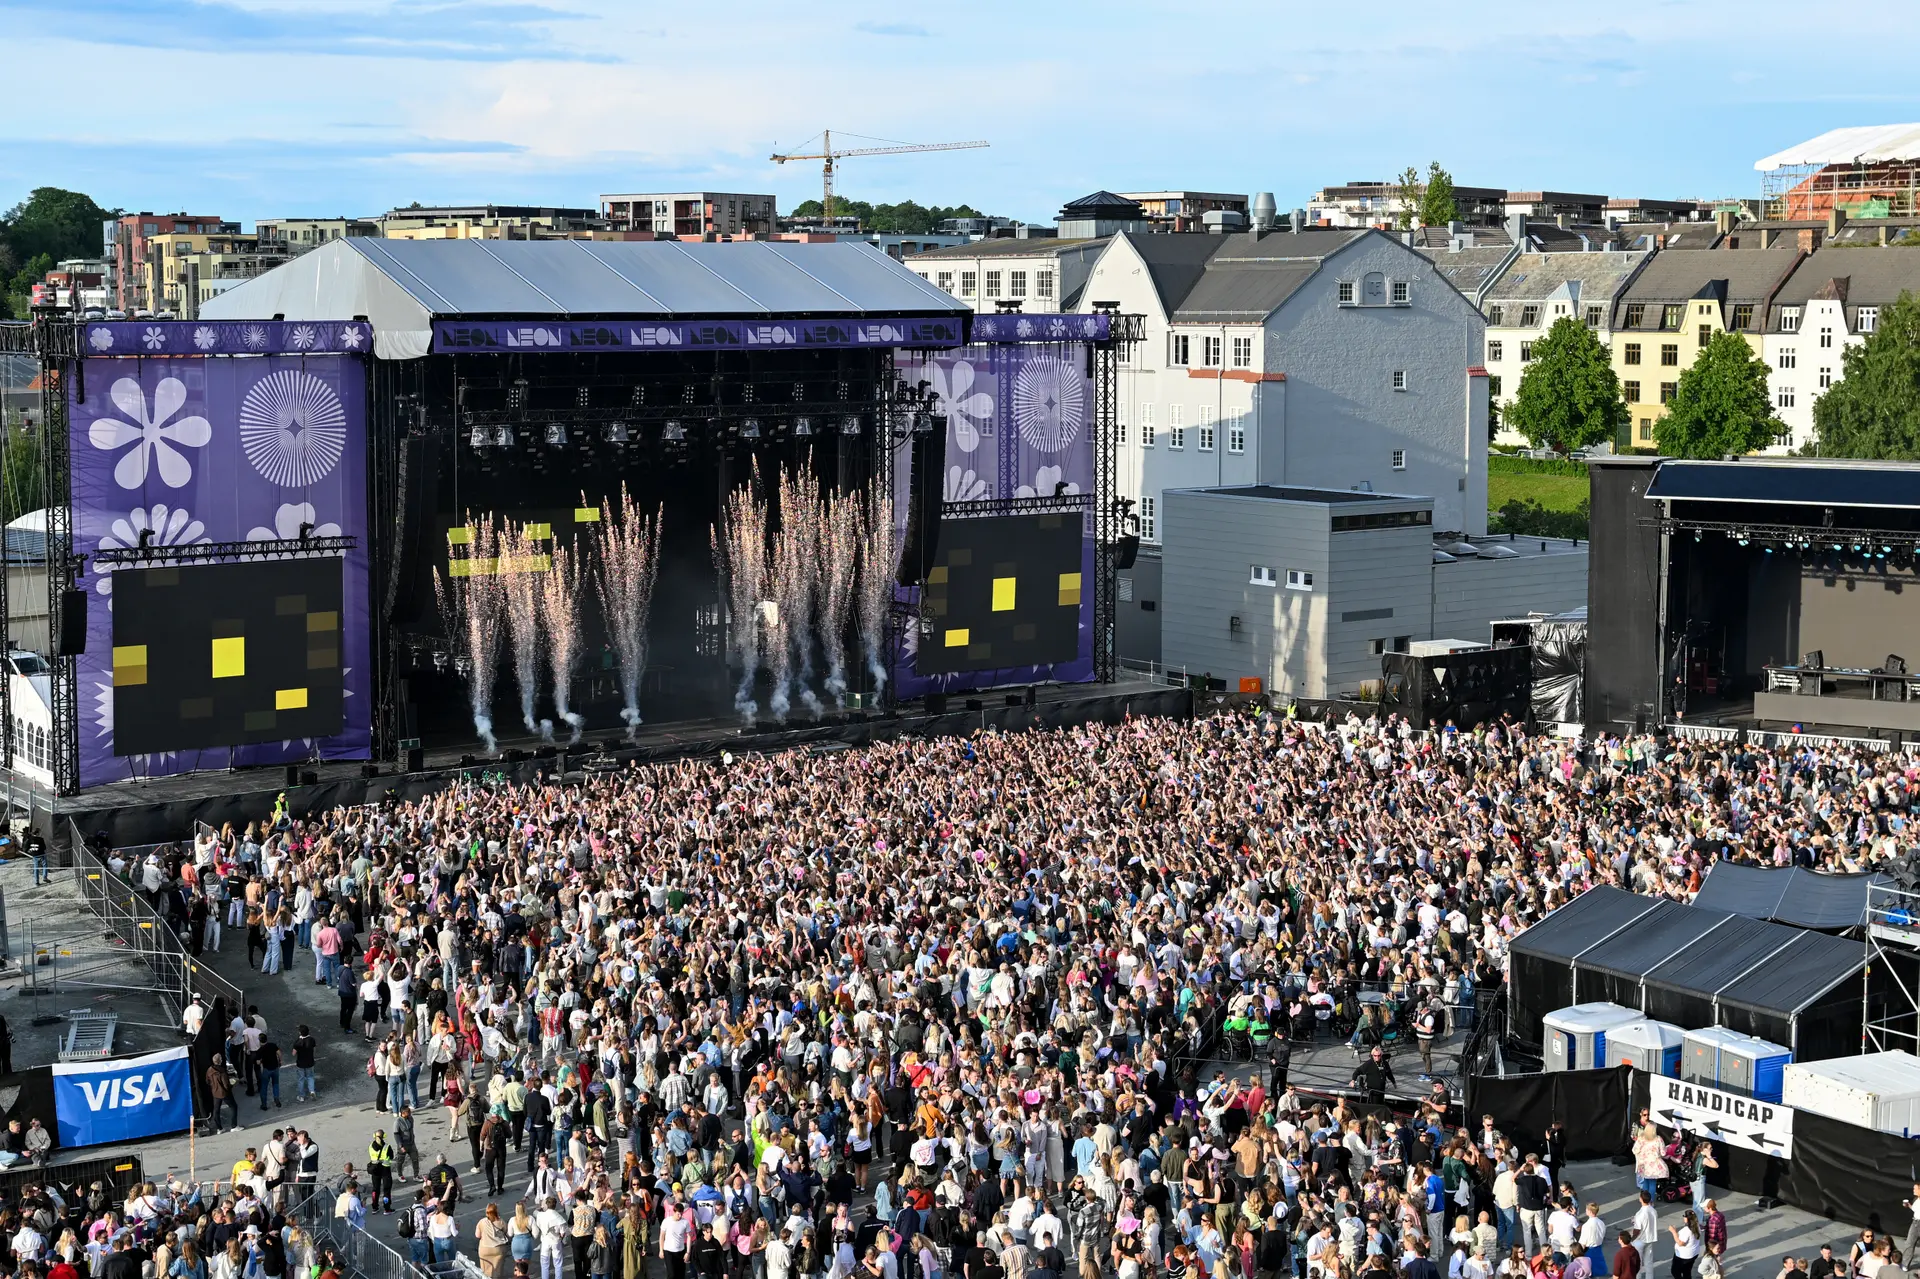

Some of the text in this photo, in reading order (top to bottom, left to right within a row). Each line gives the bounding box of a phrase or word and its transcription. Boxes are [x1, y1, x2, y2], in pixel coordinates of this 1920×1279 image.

[443, 323, 956, 346] NEON NEON NEON NEON NEON NEON NEON NEON NEON
[73, 1072, 171, 1112] VISA
[1668, 1082, 1774, 1124] HANDICAP
